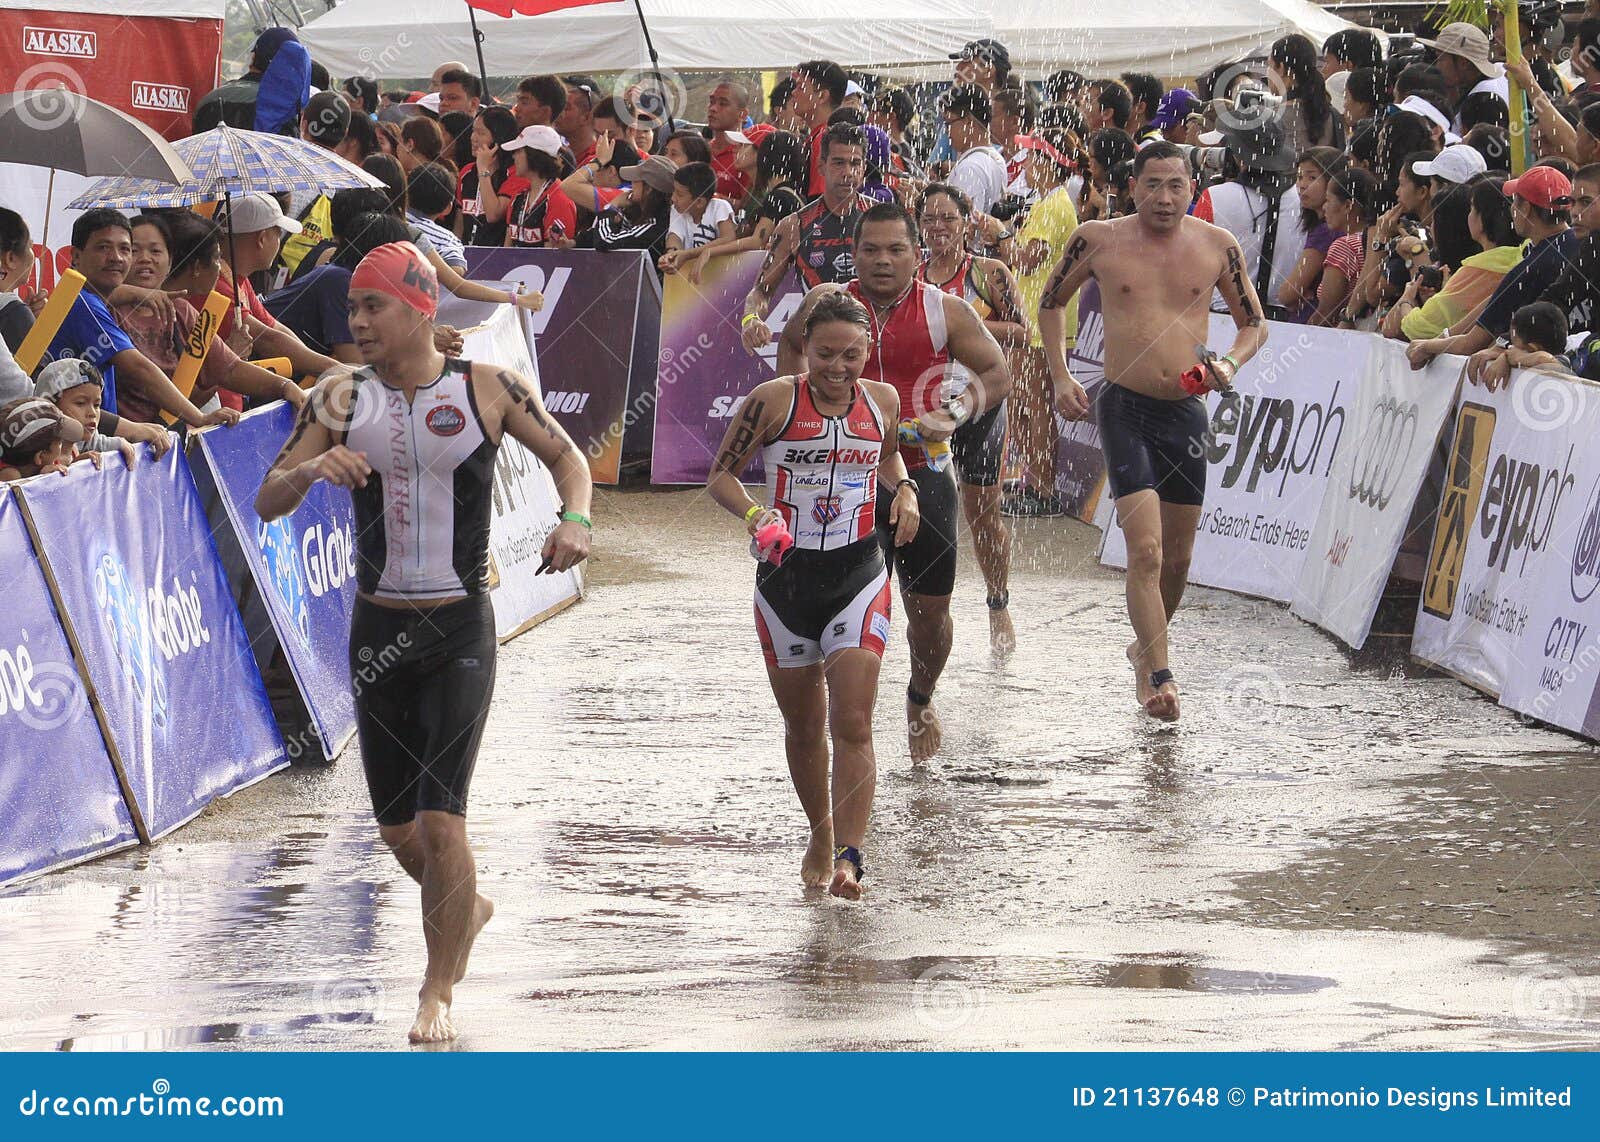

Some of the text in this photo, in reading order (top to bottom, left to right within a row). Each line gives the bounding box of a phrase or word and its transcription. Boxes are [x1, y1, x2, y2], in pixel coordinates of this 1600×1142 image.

[26, 31, 94, 55] ALASKA
[134, 85, 187, 110] ALASKA
[542, 391, 590, 414] MO!
[796, 421, 822, 429] TIMEX
[795, 478, 829, 486] UNILAB
[1210, 507, 1250, 537] Search
[1250, 514, 1281, 546] Ends
[1280, 521, 1310, 551] Here
[302, 516, 357, 597] Globe
[147, 576, 210, 661] Globe
[1544, 616, 1587, 664] CITY
